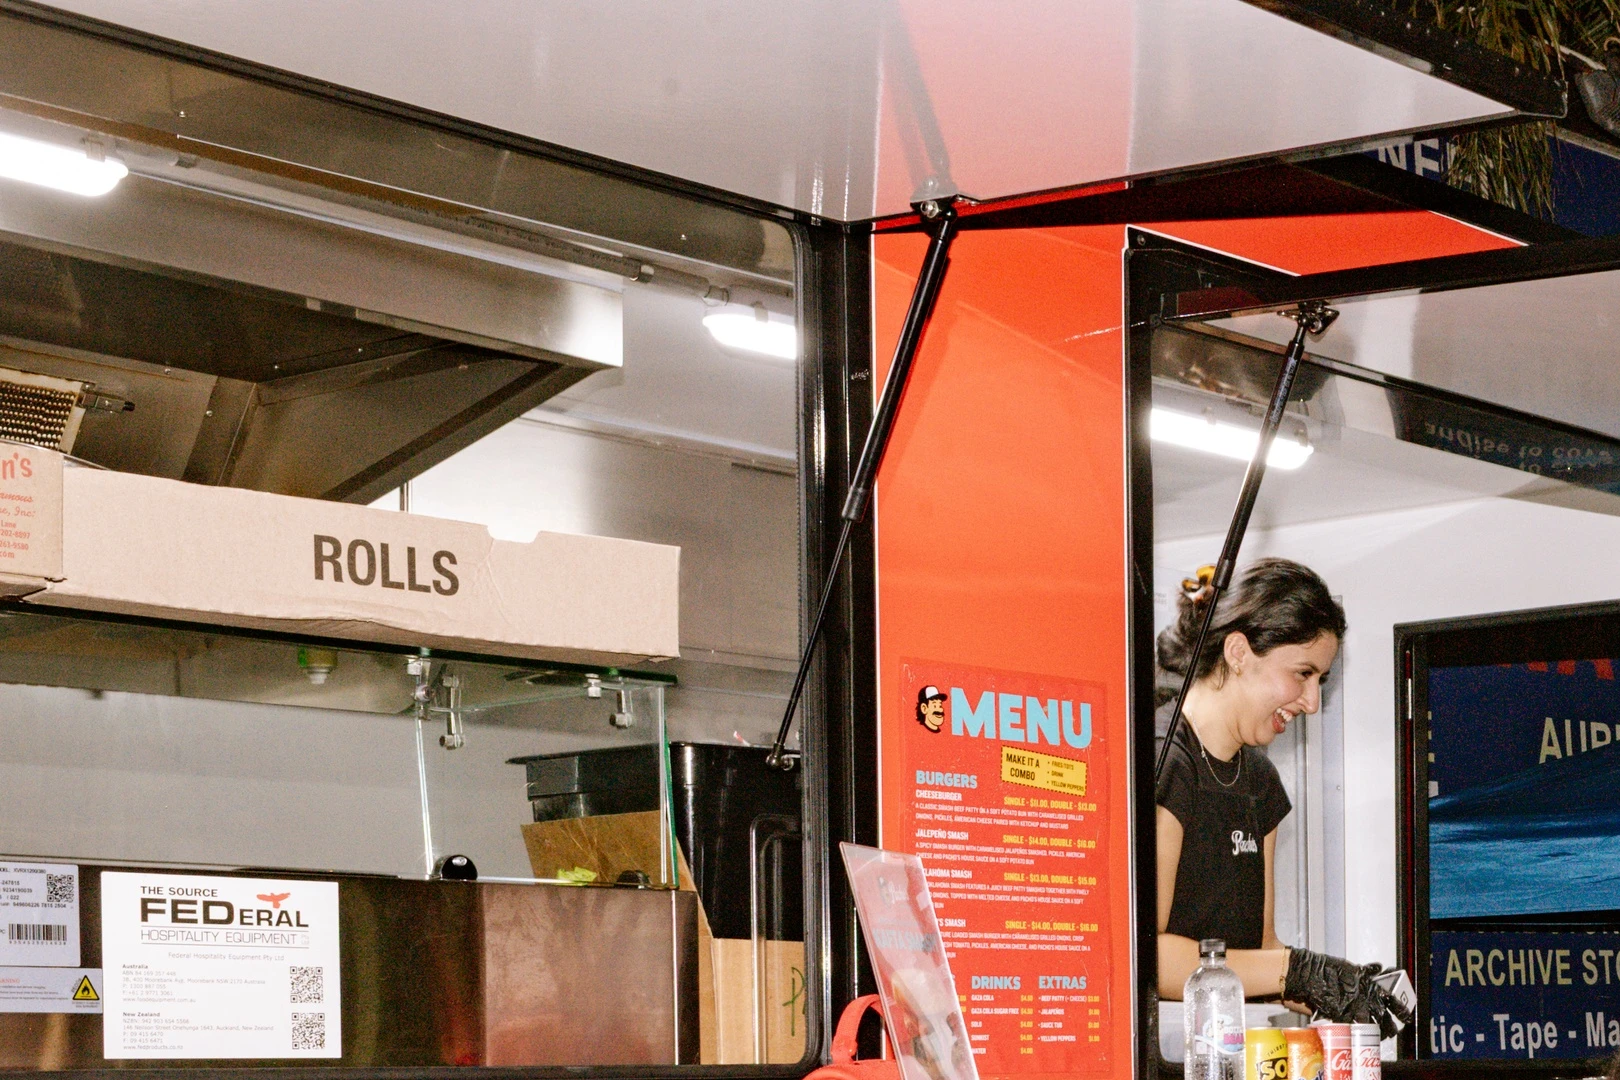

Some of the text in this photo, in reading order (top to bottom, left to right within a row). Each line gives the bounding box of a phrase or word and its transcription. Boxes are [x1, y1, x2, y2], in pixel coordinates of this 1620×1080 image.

[313, 534, 459, 596] ROLLS
[951, 686, 1092, 749] MENU
[1006, 753, 1040, 768] MAKE IT A
[916, 770, 977, 788] BURGERS
[1010, 768, 1035, 780] COMBO
[916, 789, 962, 801] CHEESEBURGER
[1004, 796, 1025, 806] SINGLE
[1050, 800, 1073, 810] DOUBLE
[947, 830, 968, 840] SMASH
[1003, 835, 1024, 844] SINGLE
[1050, 838, 1072, 847] DOUBLE
[951, 869, 972, 878] SMASH
[1004, 872, 1025, 881] SINGLE
[1051, 875, 1073, 884] DOUBLE
[141, 886, 218, 897] THE SOURCE
[945, 919, 966, 927] SMASH
[1005, 920, 1026, 929] SINGLE
[1053, 922, 1076, 931] DOUBLE
[141, 930, 219, 942] HOSPITALITY
[226, 932, 297, 944] EQUIPMENT
[1445, 950, 1572, 986] ARCHIVE
[972, 976, 1021, 990] DRINKS
[1039, 976, 1086, 989] EXTRAS
[1430, 1015, 1465, 1053] tic
[1493, 1014, 1558, 1058] Tape
